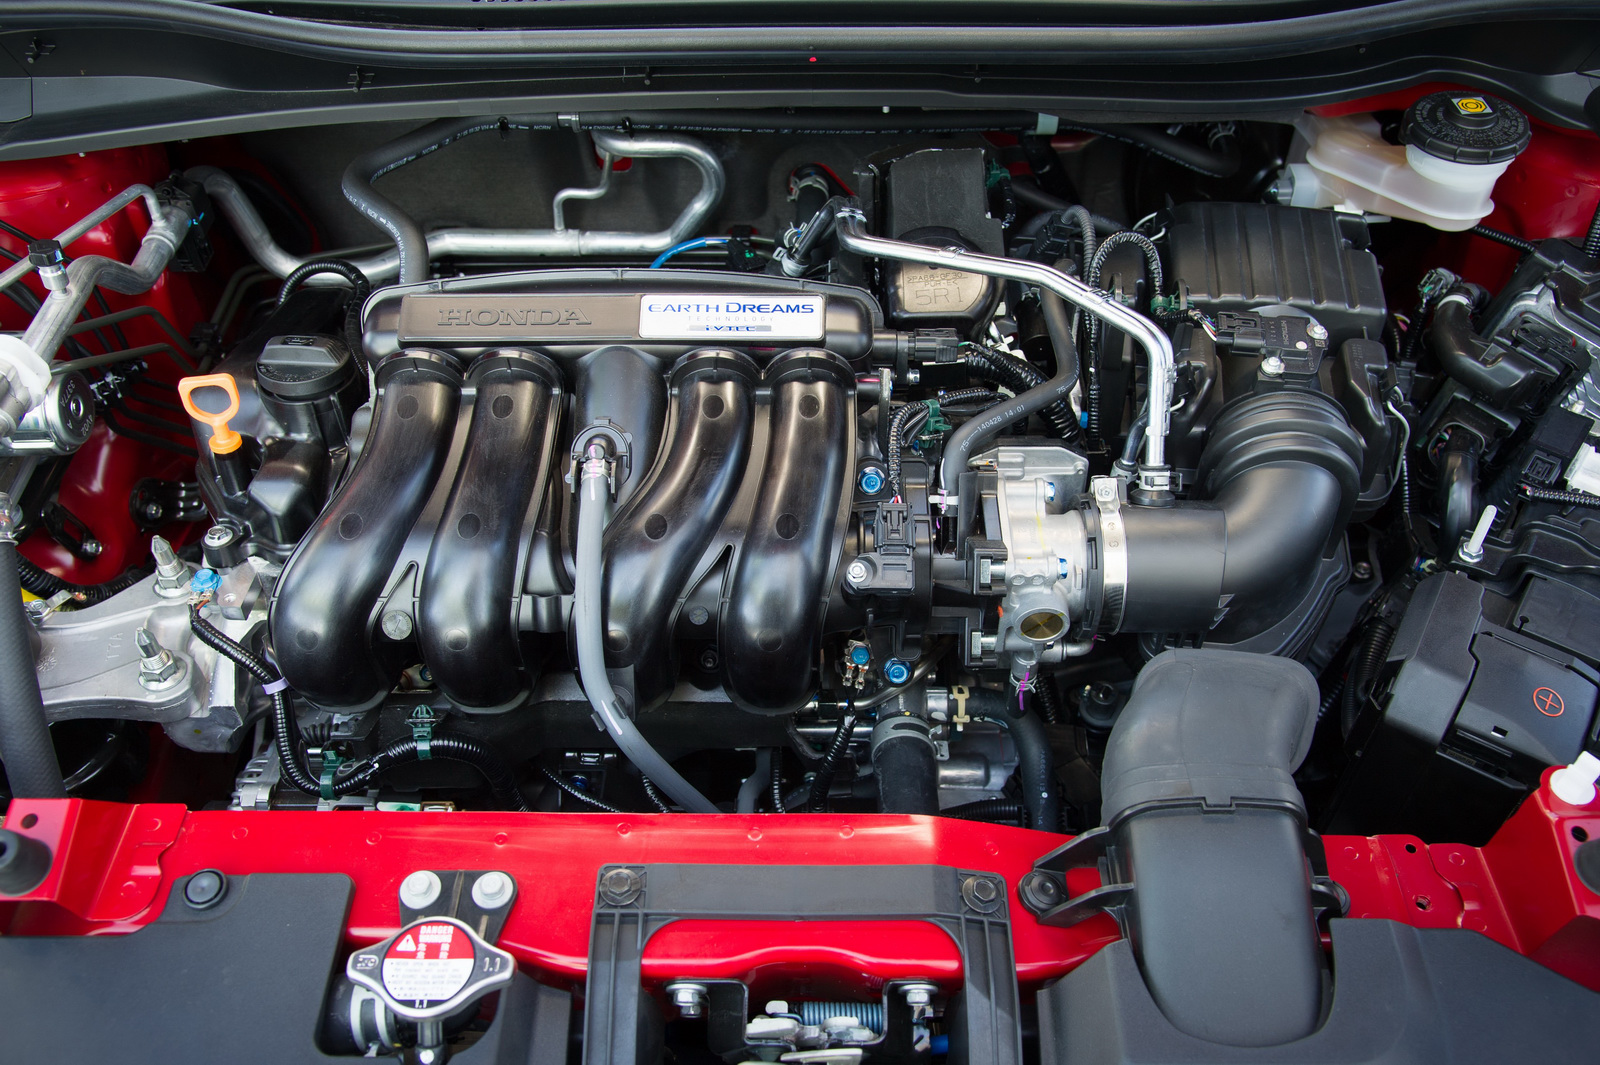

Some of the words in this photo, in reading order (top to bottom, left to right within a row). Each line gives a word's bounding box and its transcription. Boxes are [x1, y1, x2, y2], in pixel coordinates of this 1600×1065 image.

[648, 303, 719, 313] EARTH
[725, 302, 814, 313] DREAMS
[437, 308, 592, 326] HONDA
[1281, 320, 1290, 345] HITACHI
[66, 418, 73, 430] A
[977, 415, 1003, 432] 140428
[420, 925, 454, 935] DANGER
[483, 956, 501, 973] 1.1
